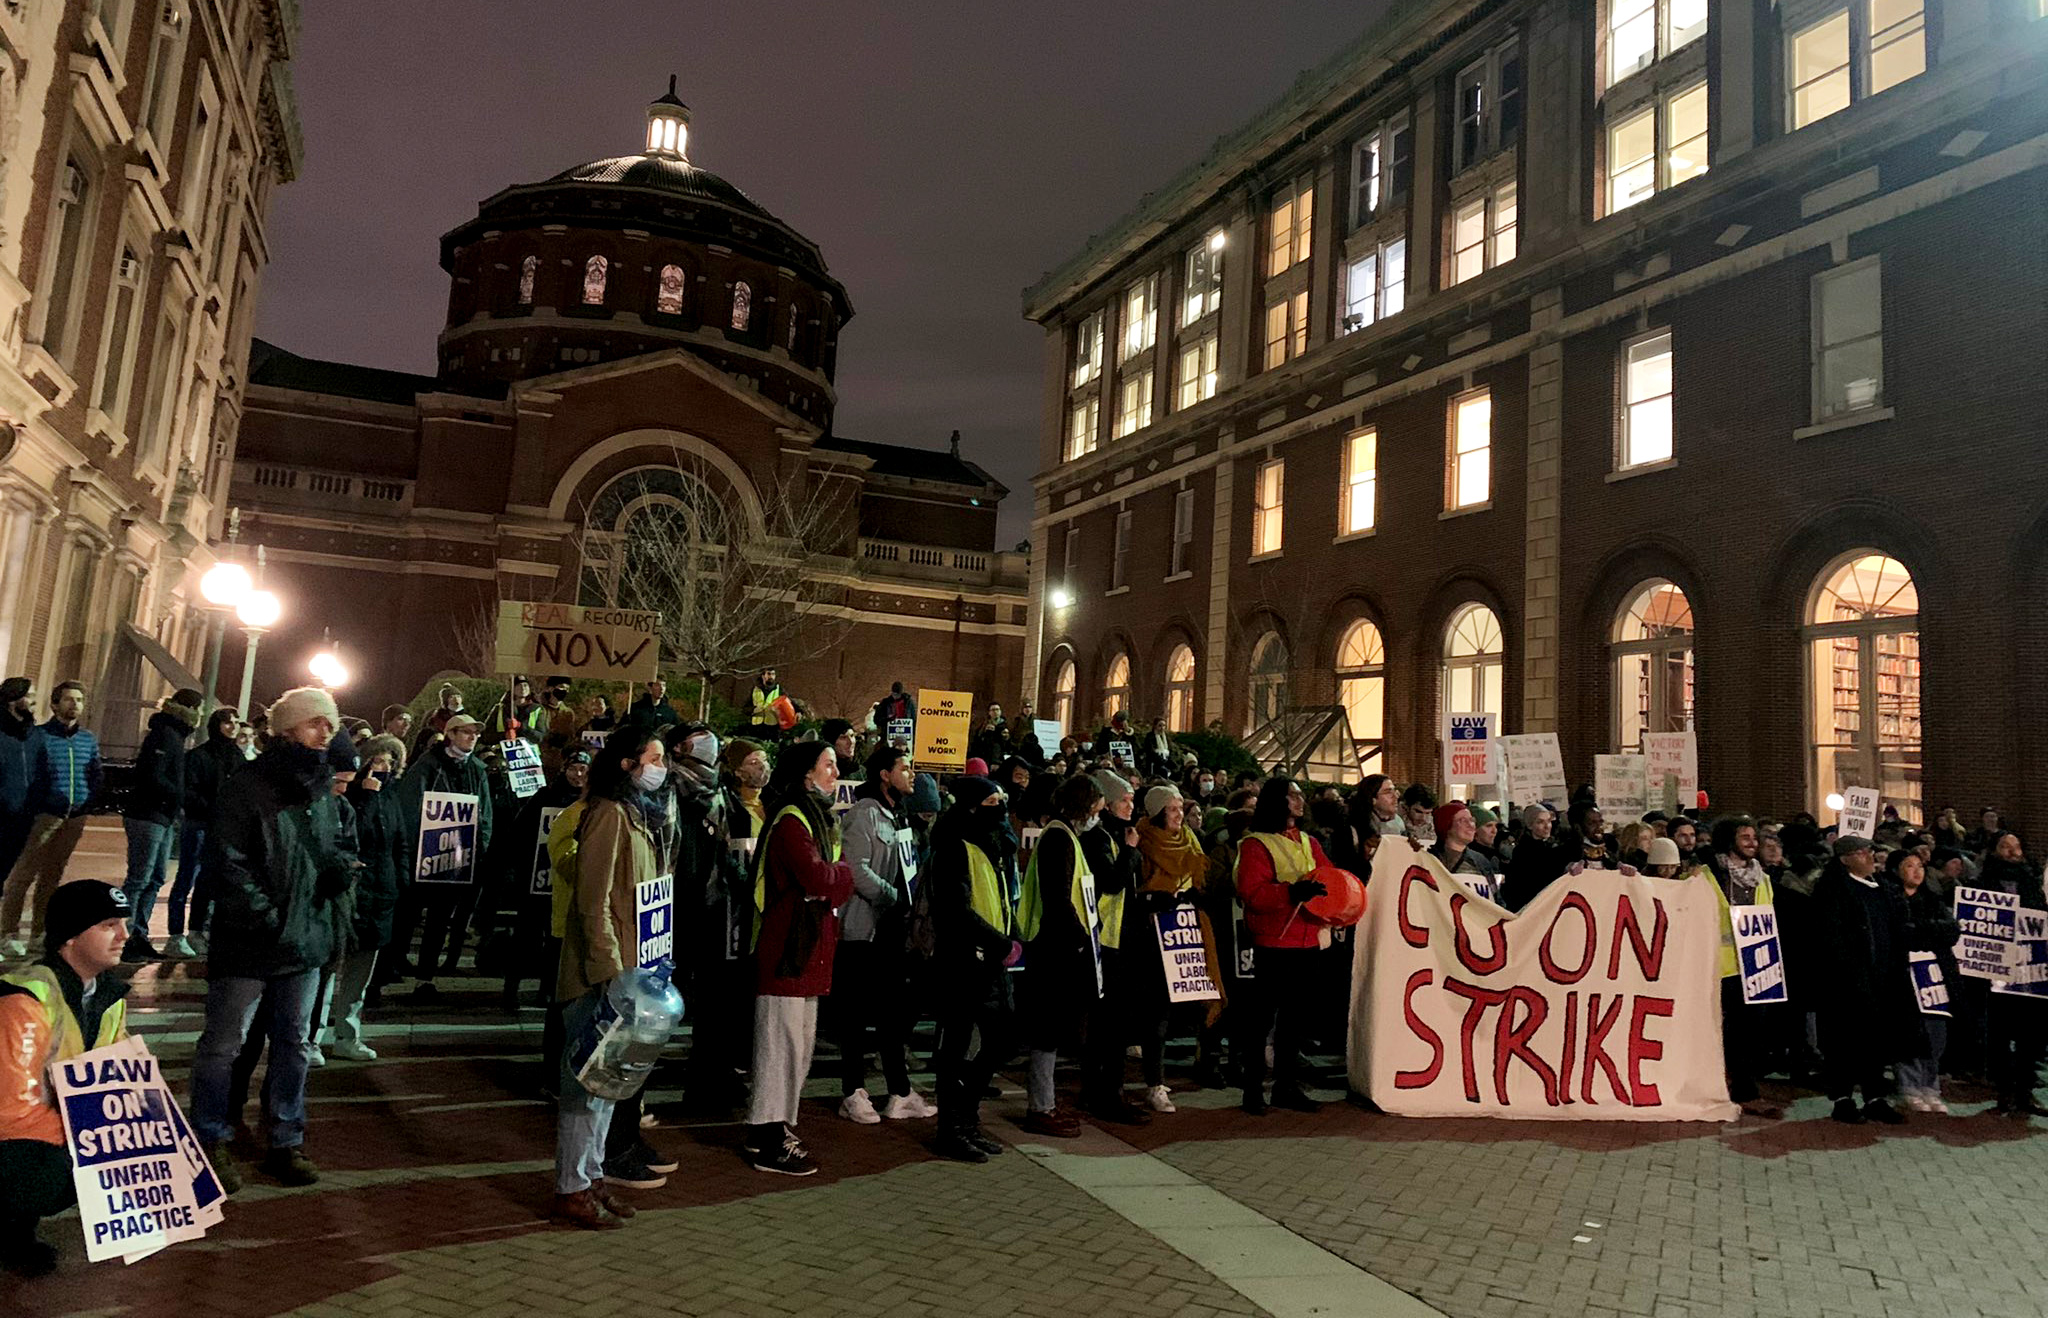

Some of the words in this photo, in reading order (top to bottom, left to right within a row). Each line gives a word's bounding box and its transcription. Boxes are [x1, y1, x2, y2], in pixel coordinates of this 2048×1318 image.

[583, 610, 663, 635] RECOURSE
[536, 632, 650, 669] NOW
[920, 708, 969, 718] CONTRACT?
[941, 700, 953, 708] NO
[1452, 717, 1486, 727] UAW
[928, 746, 957, 755] WORK!
[936, 737, 949, 745] NO
[1452, 754, 1486, 775] STRIKE
[426, 800, 474, 823] UAW
[1851, 795, 1870, 809] FAIR
[1847, 818, 1866, 831] NOW
[438, 829, 461, 852] ON
[421, 847, 471, 877] STRIKE
[641, 878, 671, 906] UAW
[1961, 889, 2015, 907] UAW
[650, 908, 665, 934] ON
[1176, 910, 1197, 927] ON
[1974, 907, 1998, 922] ON
[1163, 927, 1203, 947] STRI
[1538, 891, 1668, 985] ON
[1959, 918, 2014, 939] STRIKE
[640, 931, 671, 965] STRIKE
[1964, 938, 2004, 953] UNFAIR
[1965, 949, 2002, 963] LABOR
[1174, 952, 1205, 965] UNFAI
[1179, 965, 1209, 979] LABO
[1395, 968, 1674, 1107] STRIKE
[64, 1059, 152, 1088] UAW
[102, 1091, 143, 1121] ON
[78, 1120, 174, 1157] STRIKE
[98, 1160, 173, 1190] UNFAIR
[107, 1184, 175, 1215] LABOR
[93, 1205, 195, 1245] PRACTICE
